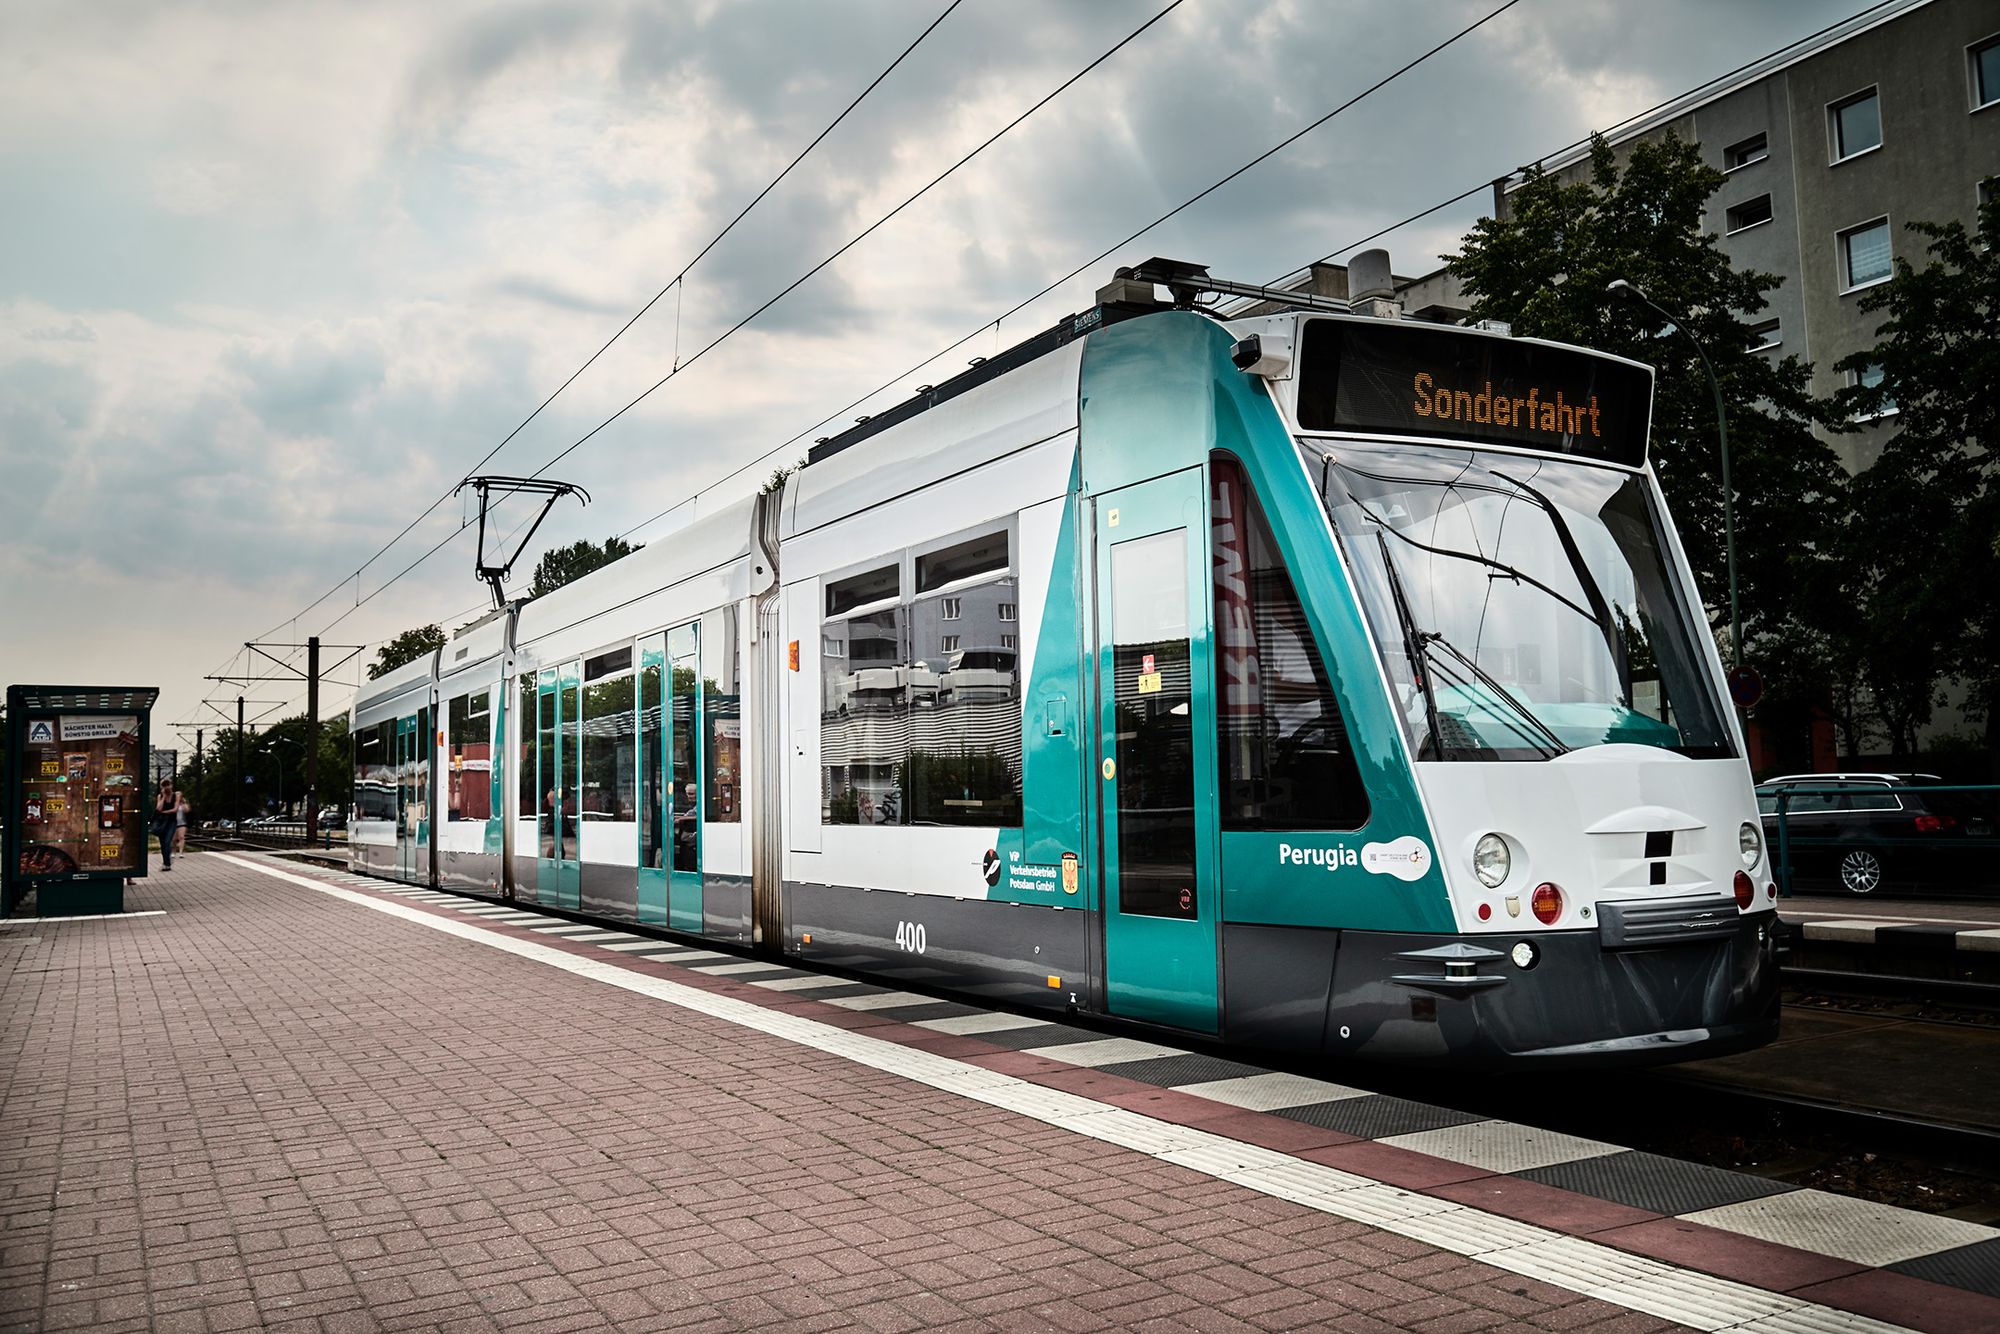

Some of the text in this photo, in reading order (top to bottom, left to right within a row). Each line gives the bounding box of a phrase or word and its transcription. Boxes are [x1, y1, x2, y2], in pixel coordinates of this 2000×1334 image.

[1074, 310, 1100, 330] SIEMENS
[1413, 372, 1601, 437] Sonderfahrt
[1279, 842, 1358, 872] Perugia
[1010, 865, 1057, 878] Verkehrsbetrieb
[1010, 878, 1056, 892] Potsdam GmbH
[895, 920, 926, 954] 400
